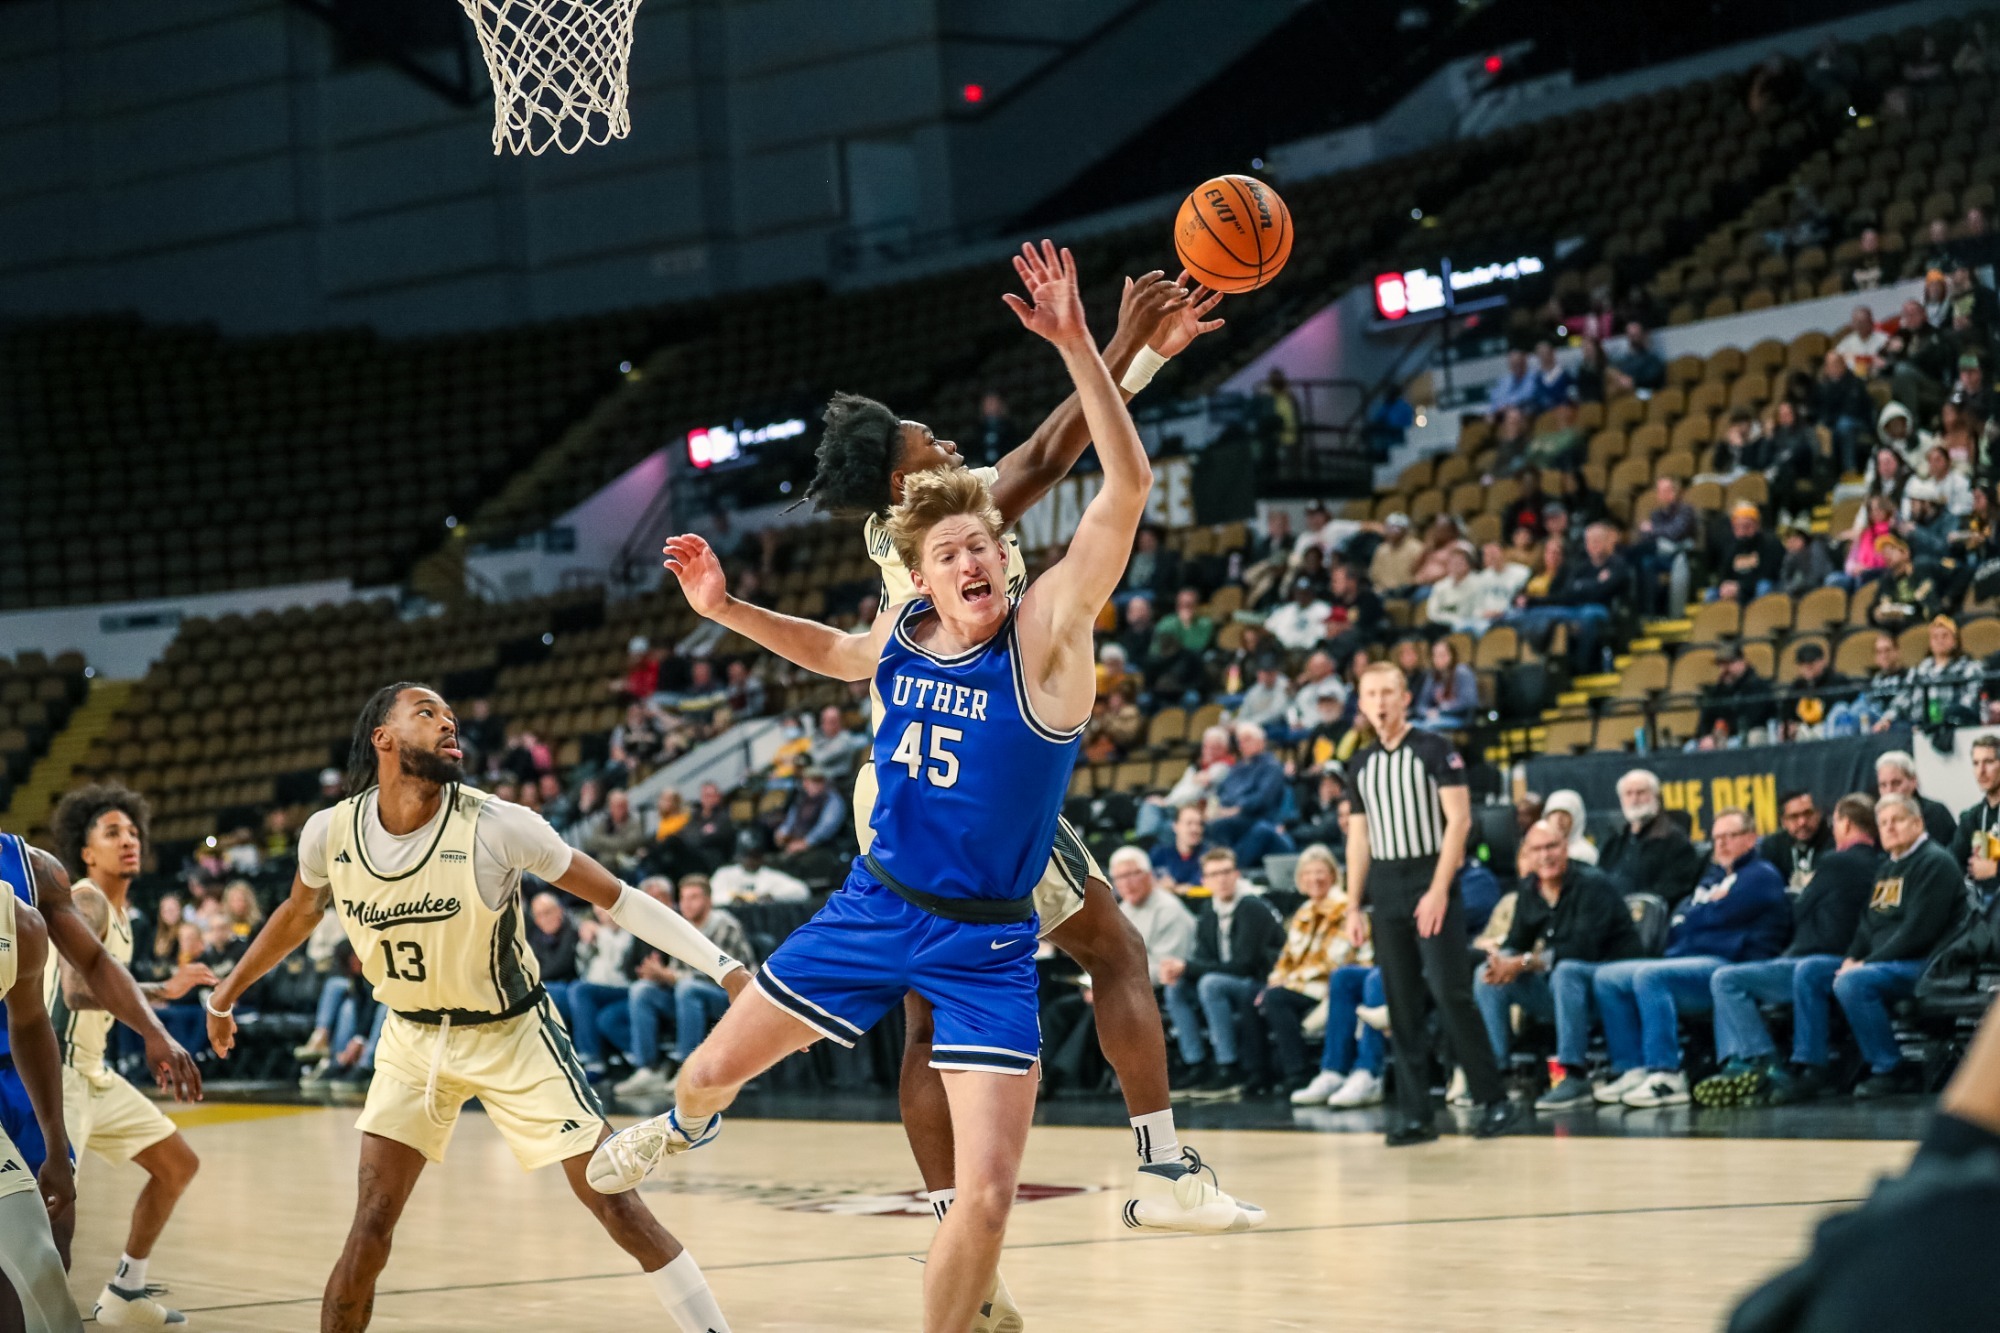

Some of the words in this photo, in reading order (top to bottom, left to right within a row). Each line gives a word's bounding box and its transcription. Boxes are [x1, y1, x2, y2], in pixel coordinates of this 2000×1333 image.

[892, 674, 988, 721] UTHER
[890, 719, 964, 789] 45
[341, 892, 461, 931] Milwaukee
[380, 939, 427, 983] 13
